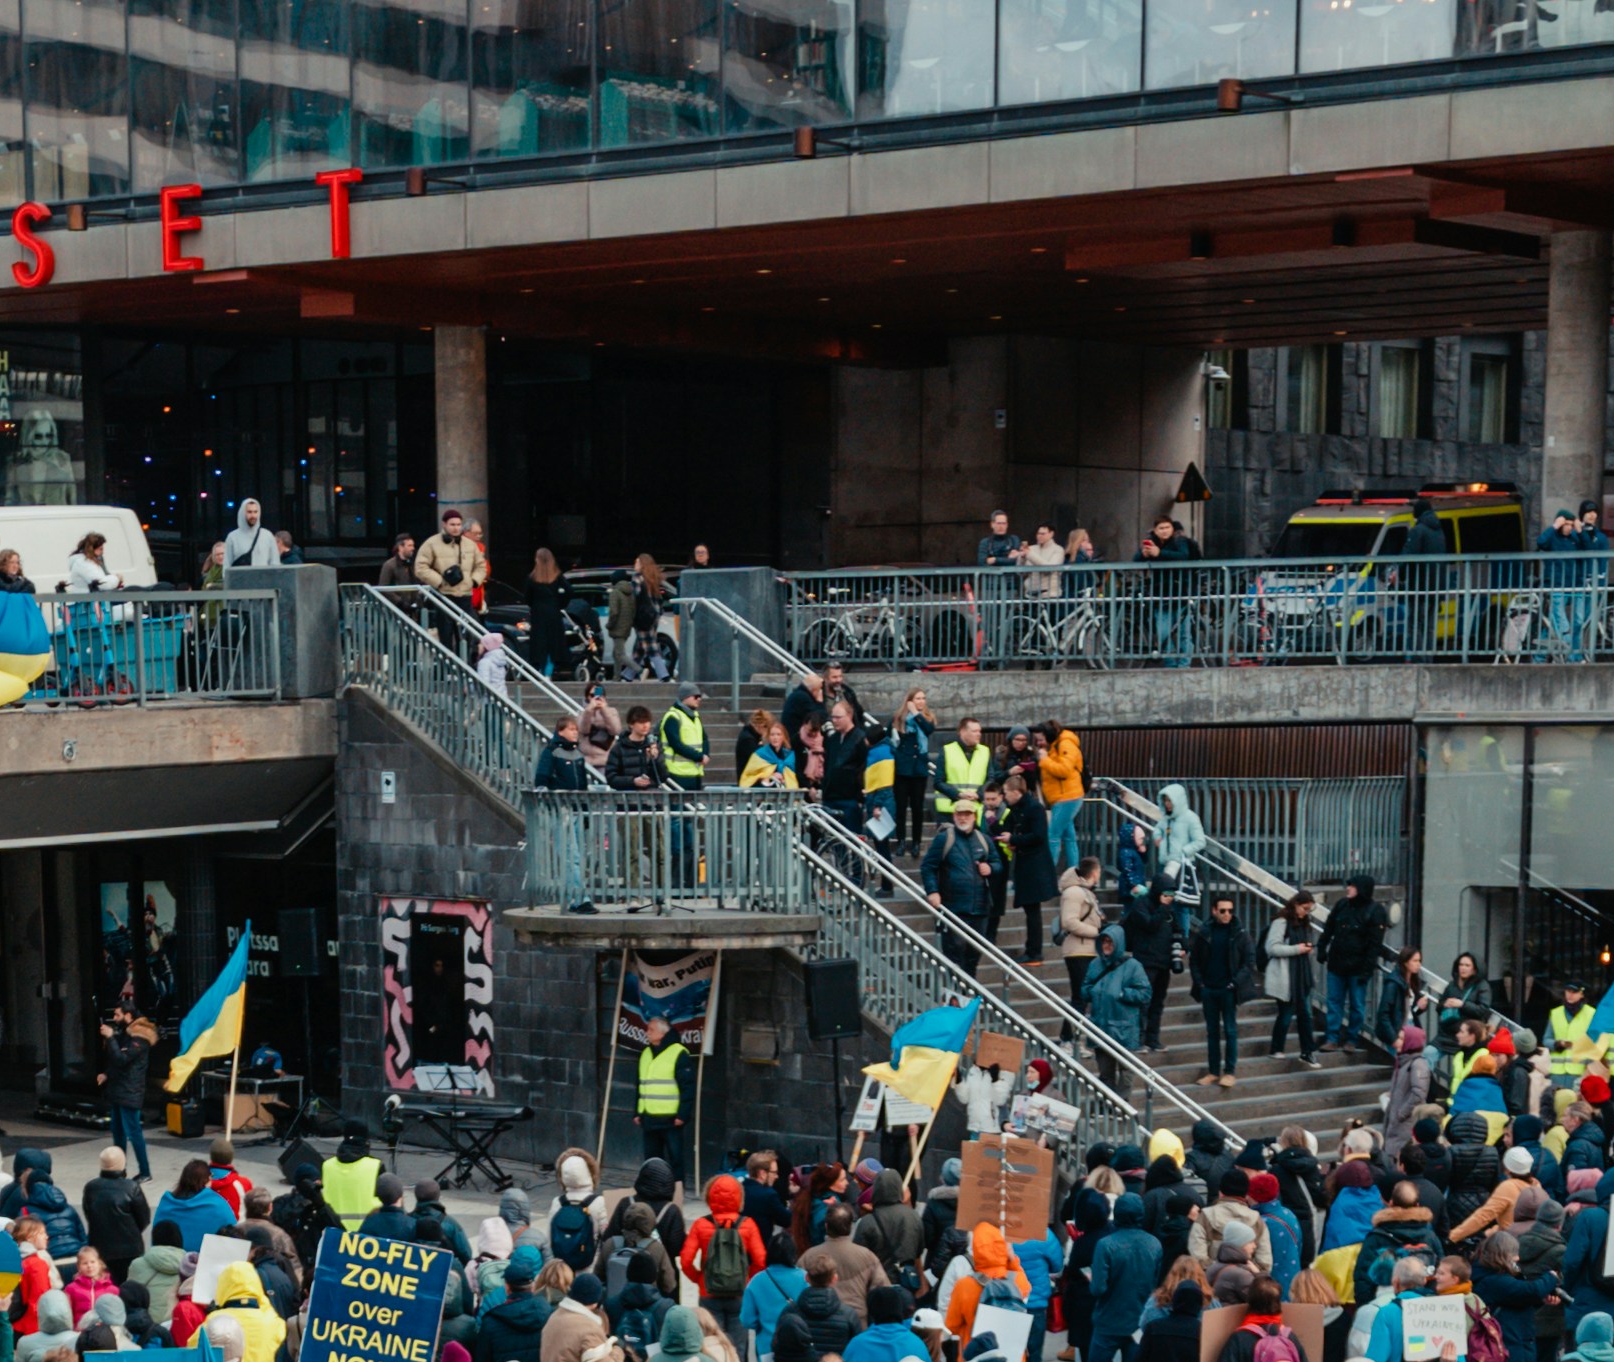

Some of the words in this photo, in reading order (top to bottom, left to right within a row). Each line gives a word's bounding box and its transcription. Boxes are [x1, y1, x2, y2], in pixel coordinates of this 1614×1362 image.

[338, 1231, 438, 1273] NO-FLY
[341, 1263, 419, 1300] ZONE
[348, 1300, 403, 1326] over
